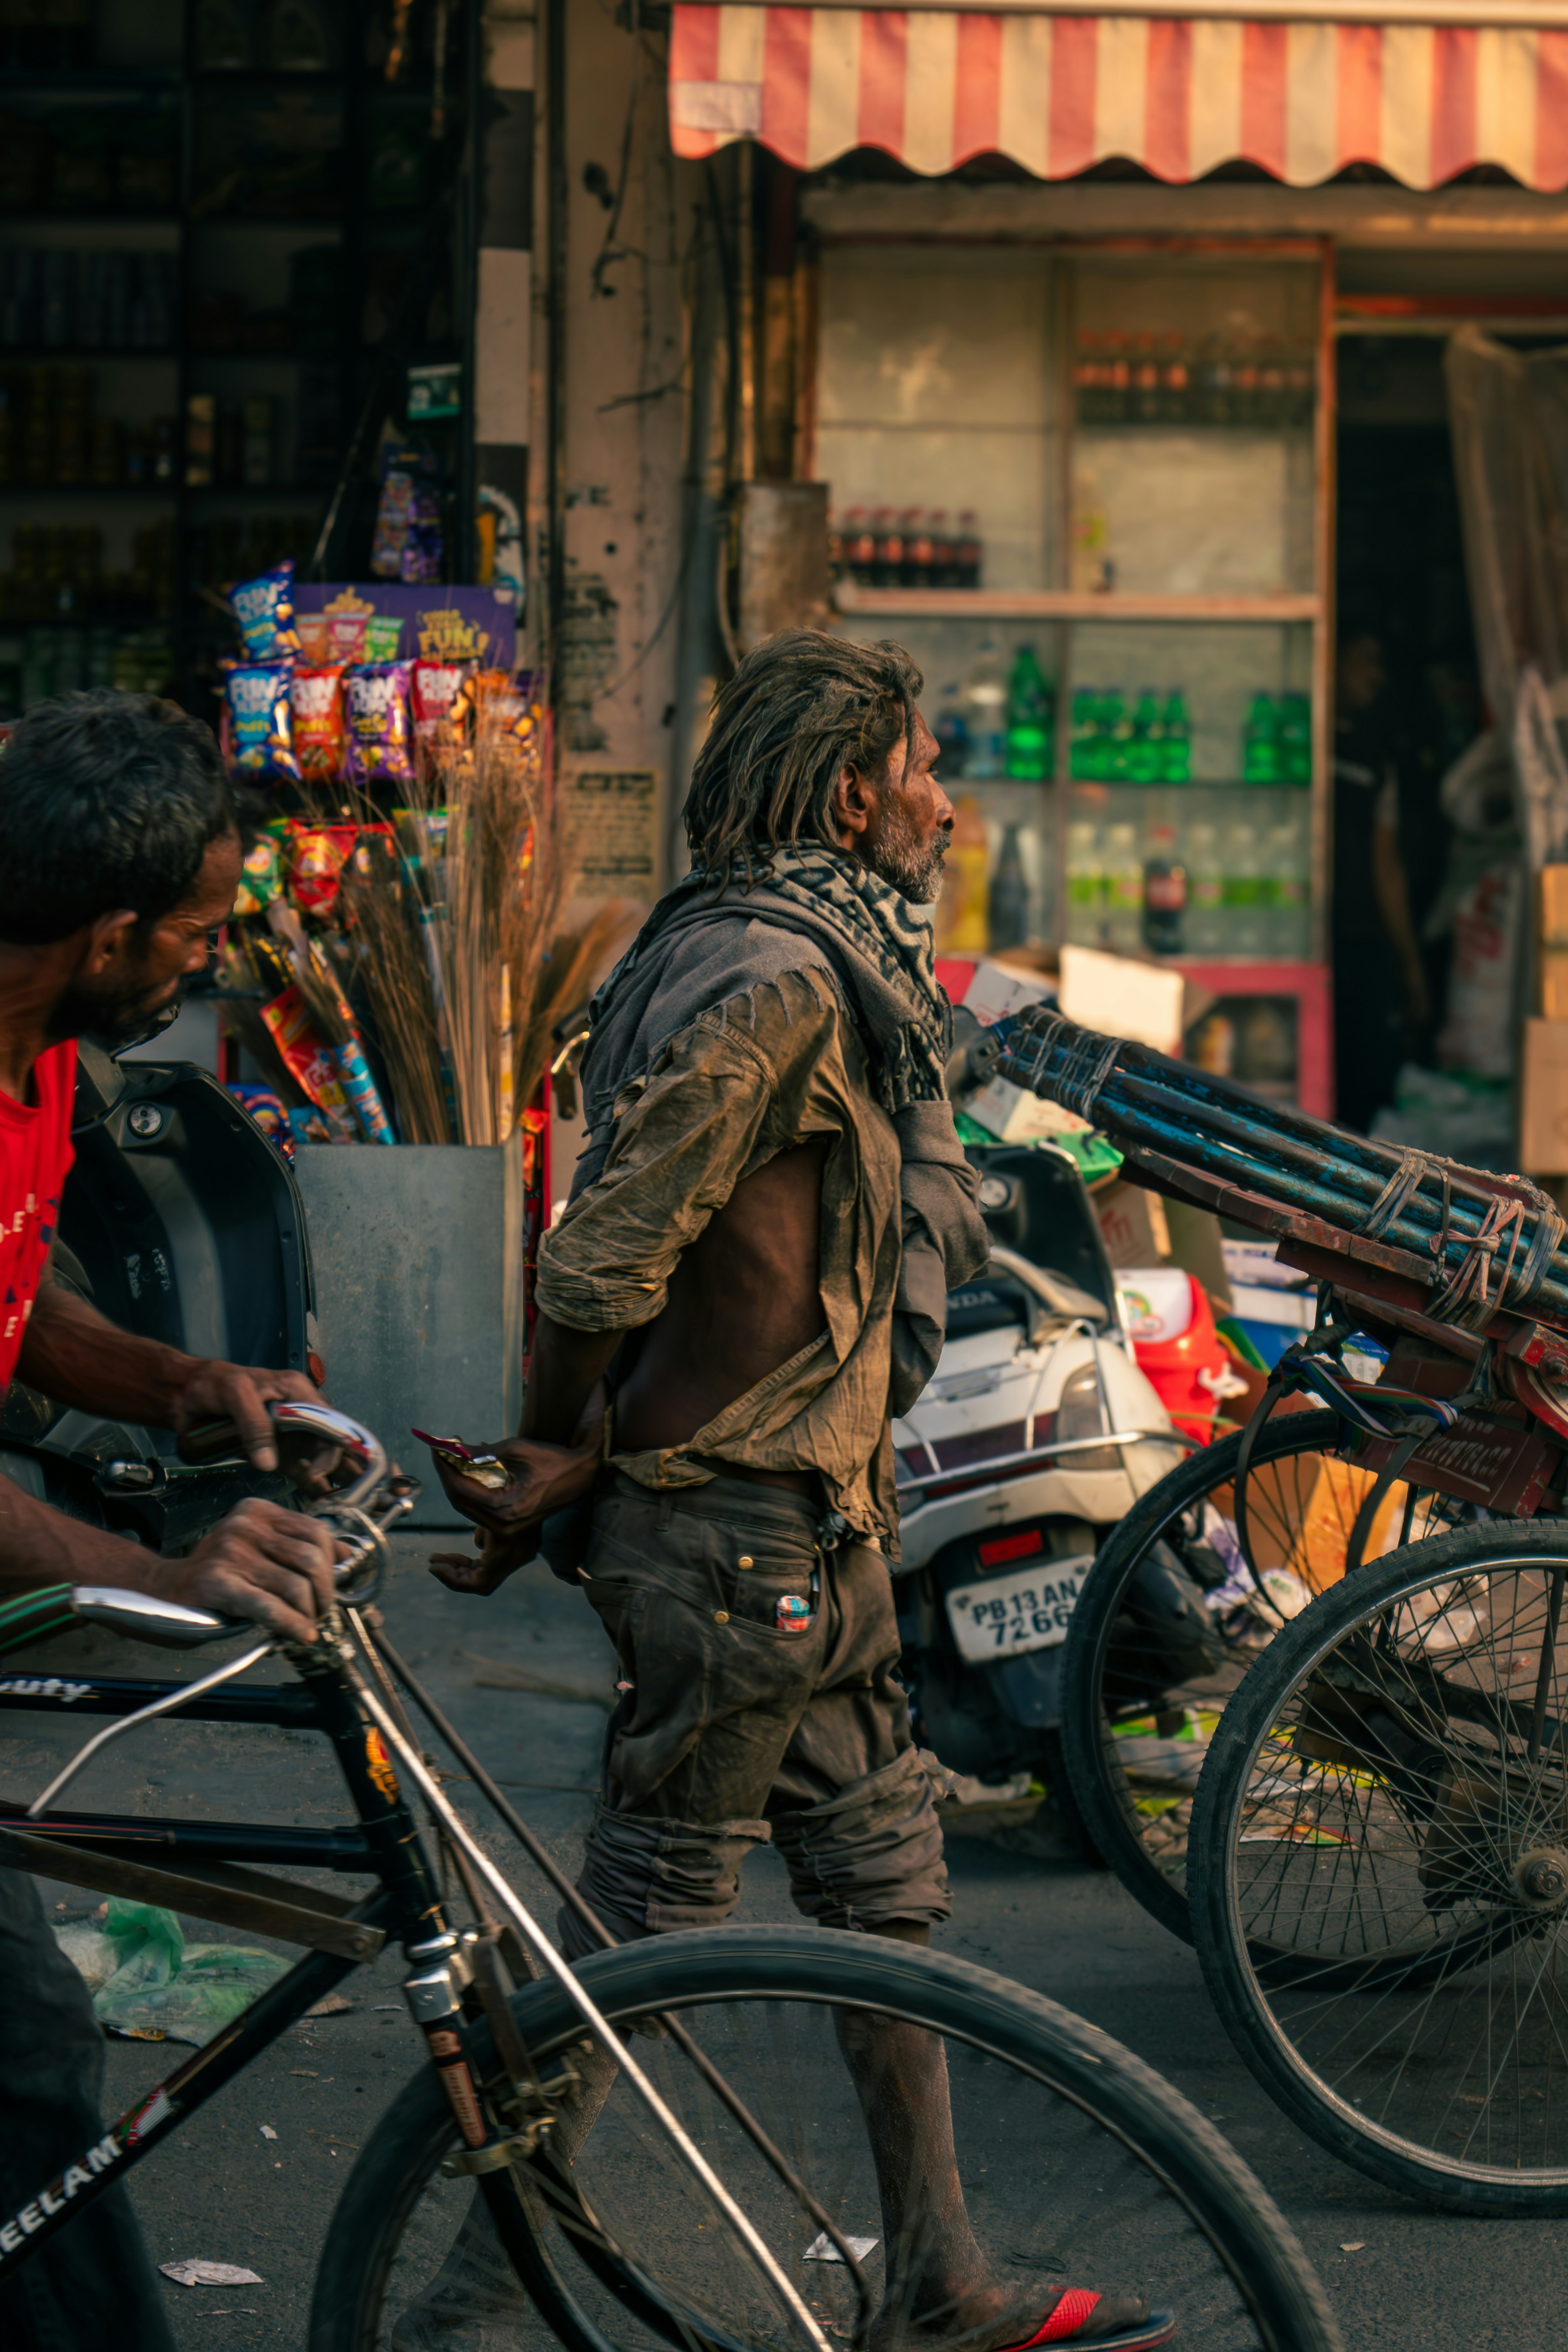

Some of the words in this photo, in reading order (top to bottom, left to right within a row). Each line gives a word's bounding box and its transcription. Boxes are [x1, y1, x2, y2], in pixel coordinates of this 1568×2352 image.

[947, 1290, 999, 1309] NDA
[987, 1604, 1073, 1647] 7266
[0, 1678, 93, 1703] uty
[0, 2133, 124, 2261] EELAM
